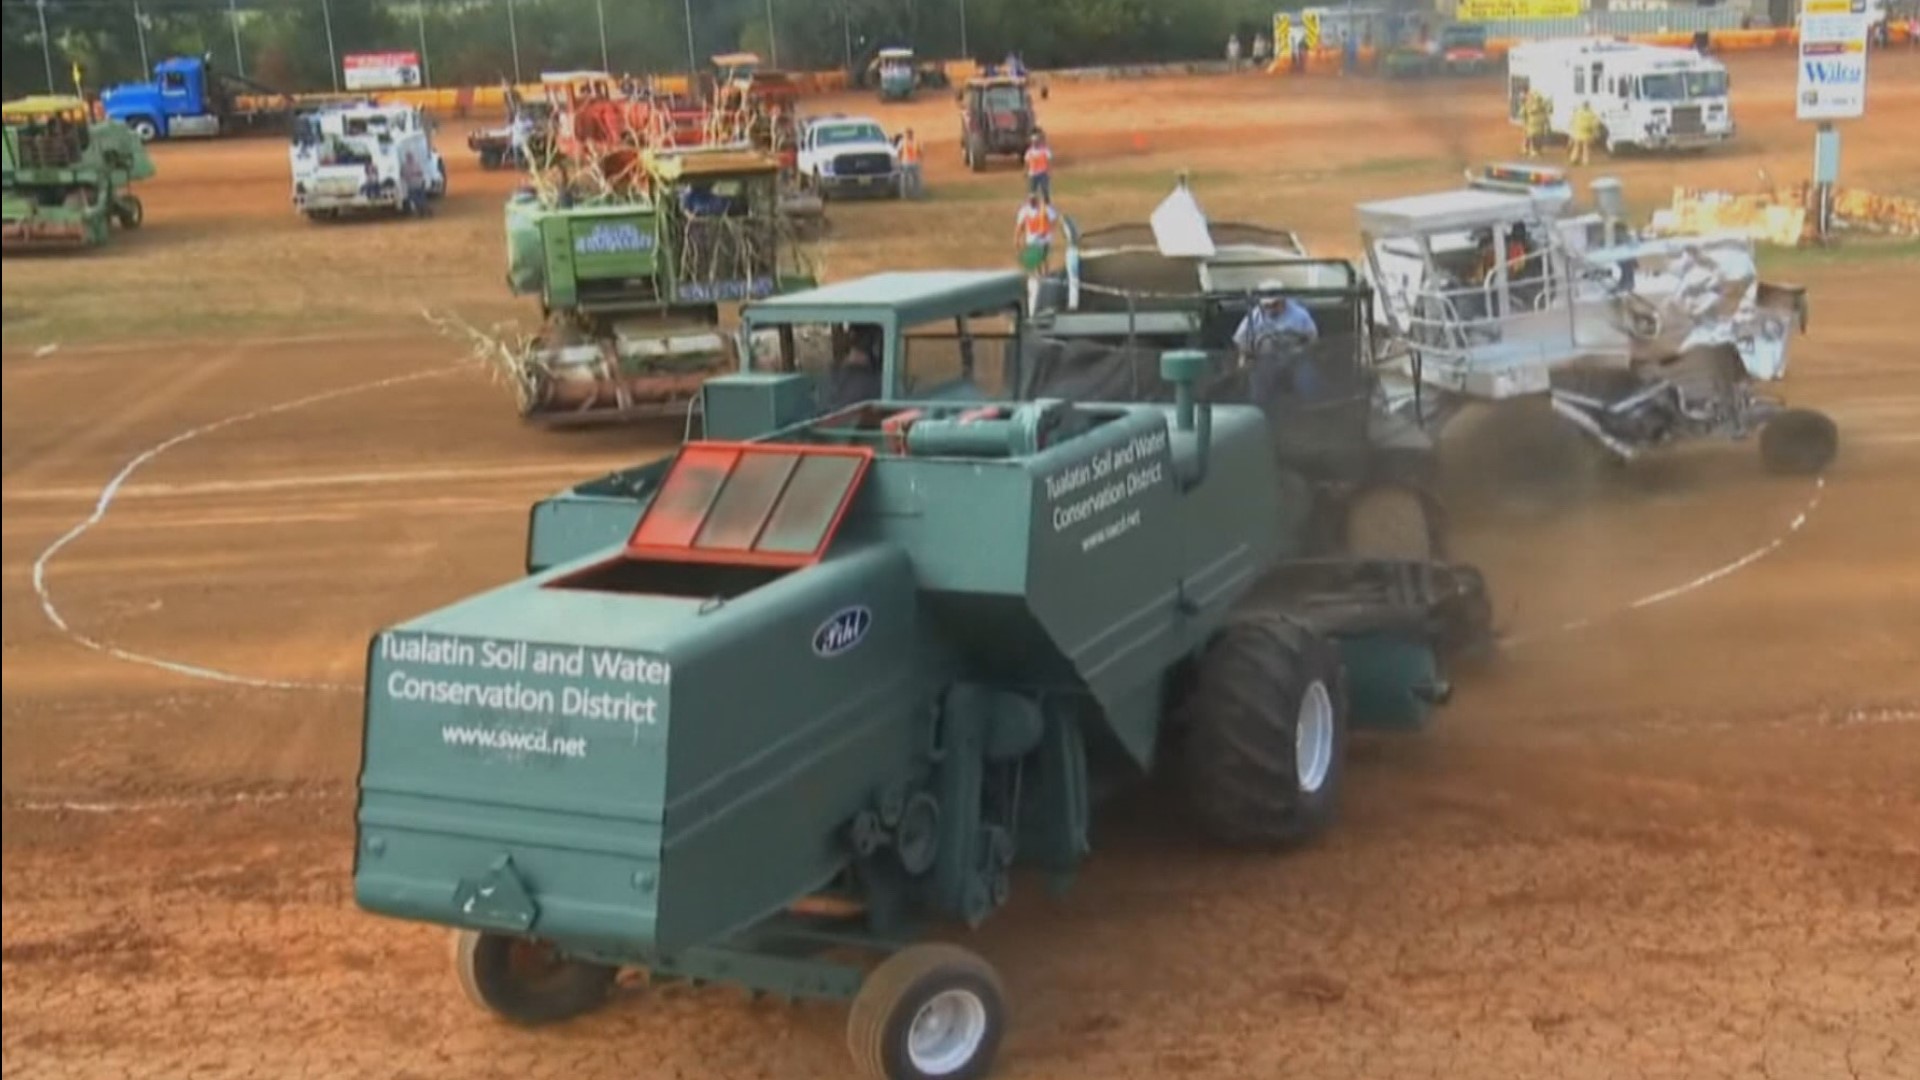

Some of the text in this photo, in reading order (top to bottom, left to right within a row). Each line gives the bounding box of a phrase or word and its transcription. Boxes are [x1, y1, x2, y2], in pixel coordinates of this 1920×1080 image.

[1045, 429, 1166, 503] Tualatin Soil and Water
[1053, 461, 1162, 532] Conservation District
[481, 640, 526, 671] Soil
[532, 648, 584, 677] and
[591, 651, 671, 686] Water
[387, 670, 657, 724] Conservation District
[442, 724, 587, 757] www.swcd.net
